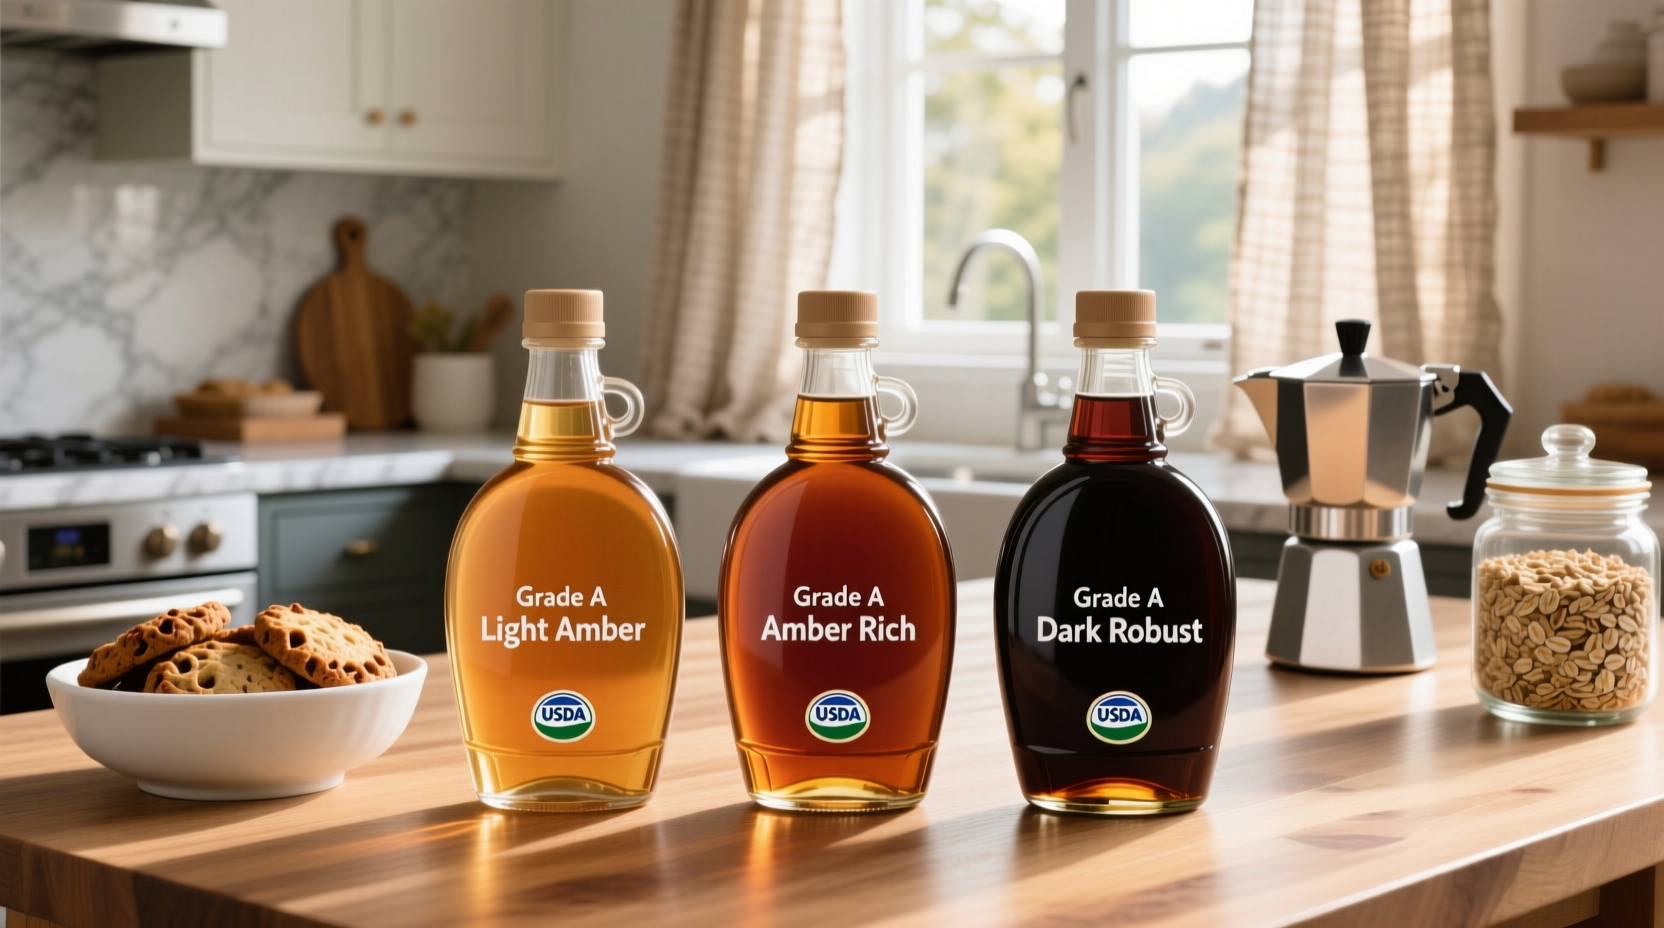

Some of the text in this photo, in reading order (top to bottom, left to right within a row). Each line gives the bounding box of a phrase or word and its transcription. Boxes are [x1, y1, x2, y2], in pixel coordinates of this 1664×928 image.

[516, 585, 607, 607] Grade A
[793, 585, 885, 607] Grade A
[1073, 586, 1164, 608] Grade A
[481, 615, 646, 649] Light Amber
[760, 615, 916, 642] Amber Rich
[1037, 615, 1203, 644] Dark Robust
[541, 706, 586, 722] USDA
[815, 706, 861, 722] USDA
[1097, 707, 1143, 723] USDA
